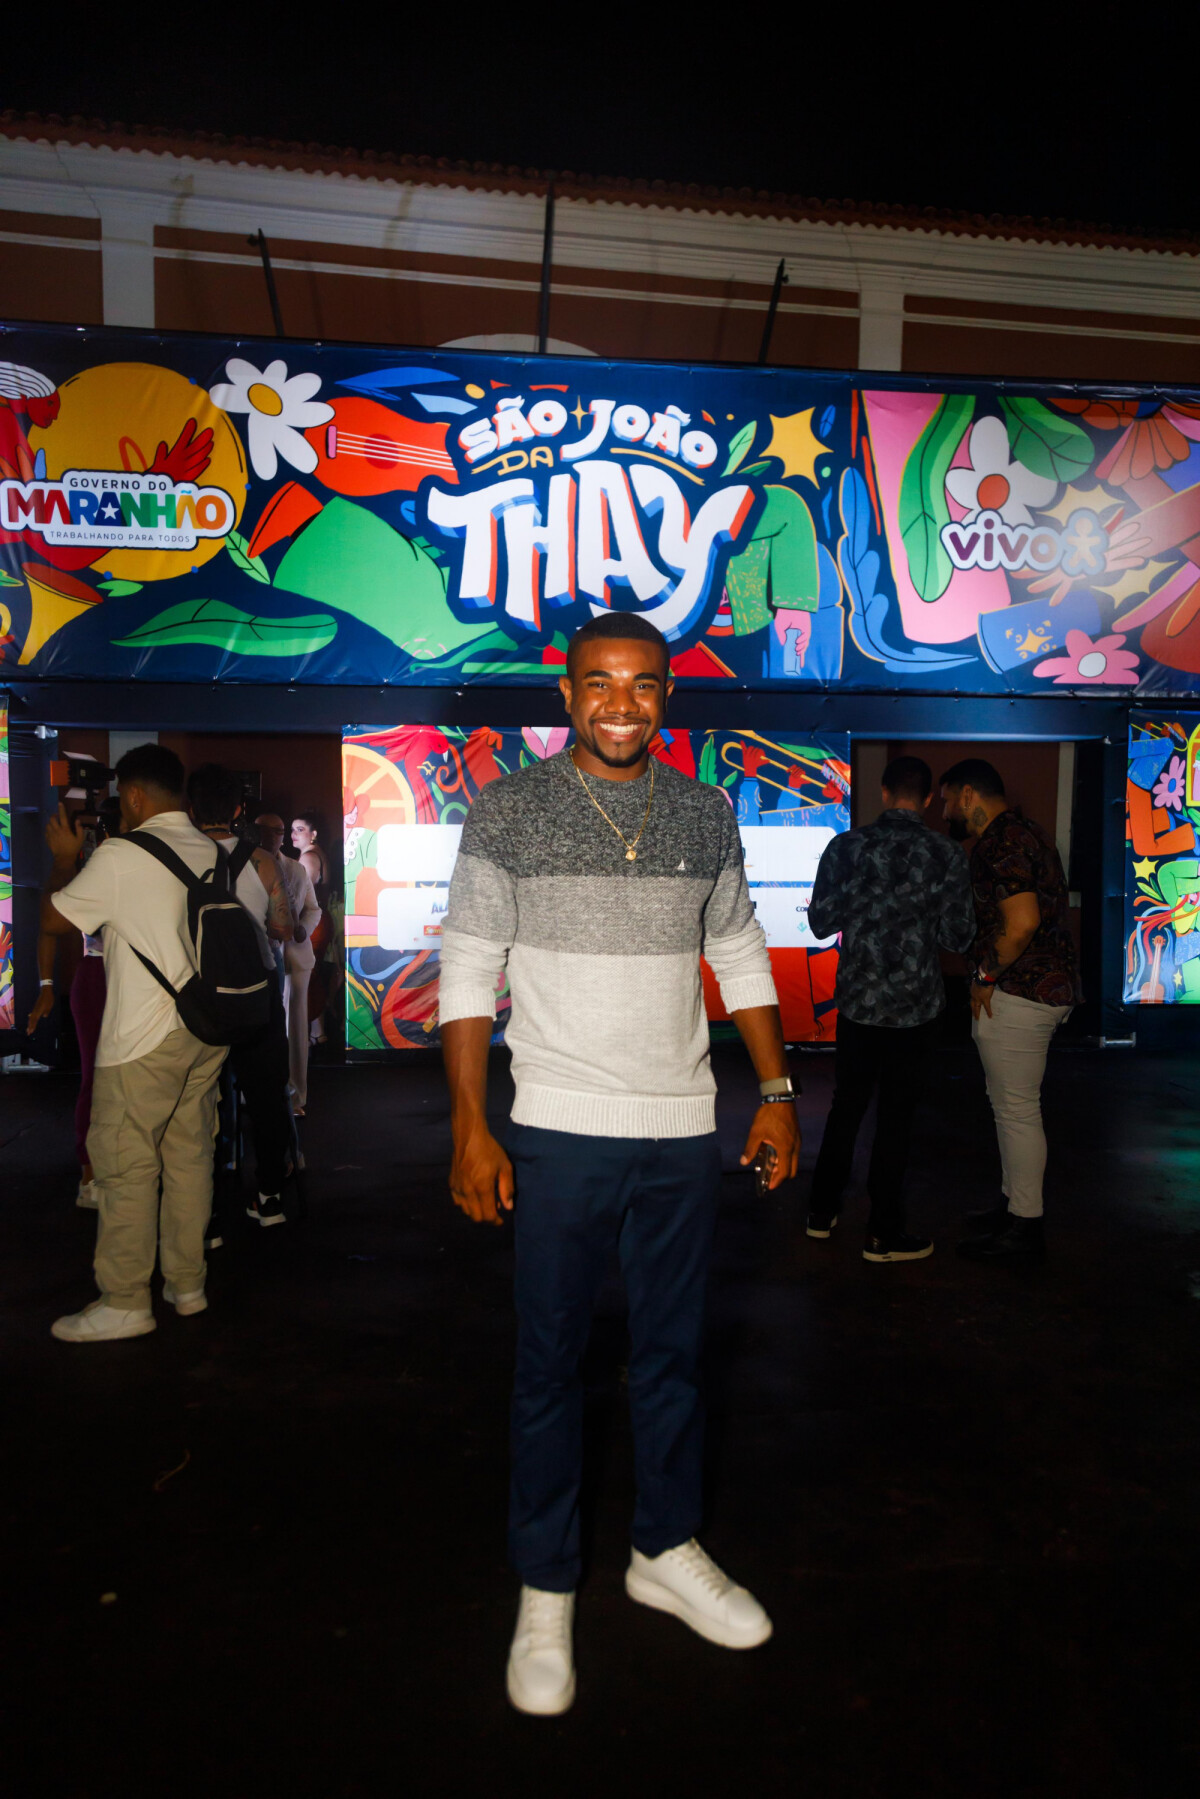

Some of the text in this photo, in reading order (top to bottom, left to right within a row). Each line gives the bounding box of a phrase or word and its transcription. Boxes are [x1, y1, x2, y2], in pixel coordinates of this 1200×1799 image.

[459, 395, 717, 468] SÃO JOÃO
[484, 446, 554, 476] DA
[69, 477, 167, 491] GOVERNO DO
[7, 487, 227, 530] MARANHÃO
[50, 530, 190, 543] TRABALHANDO PARA TODOS
[428, 460, 755, 643] THAY
[949, 518, 1057, 563] vivo
